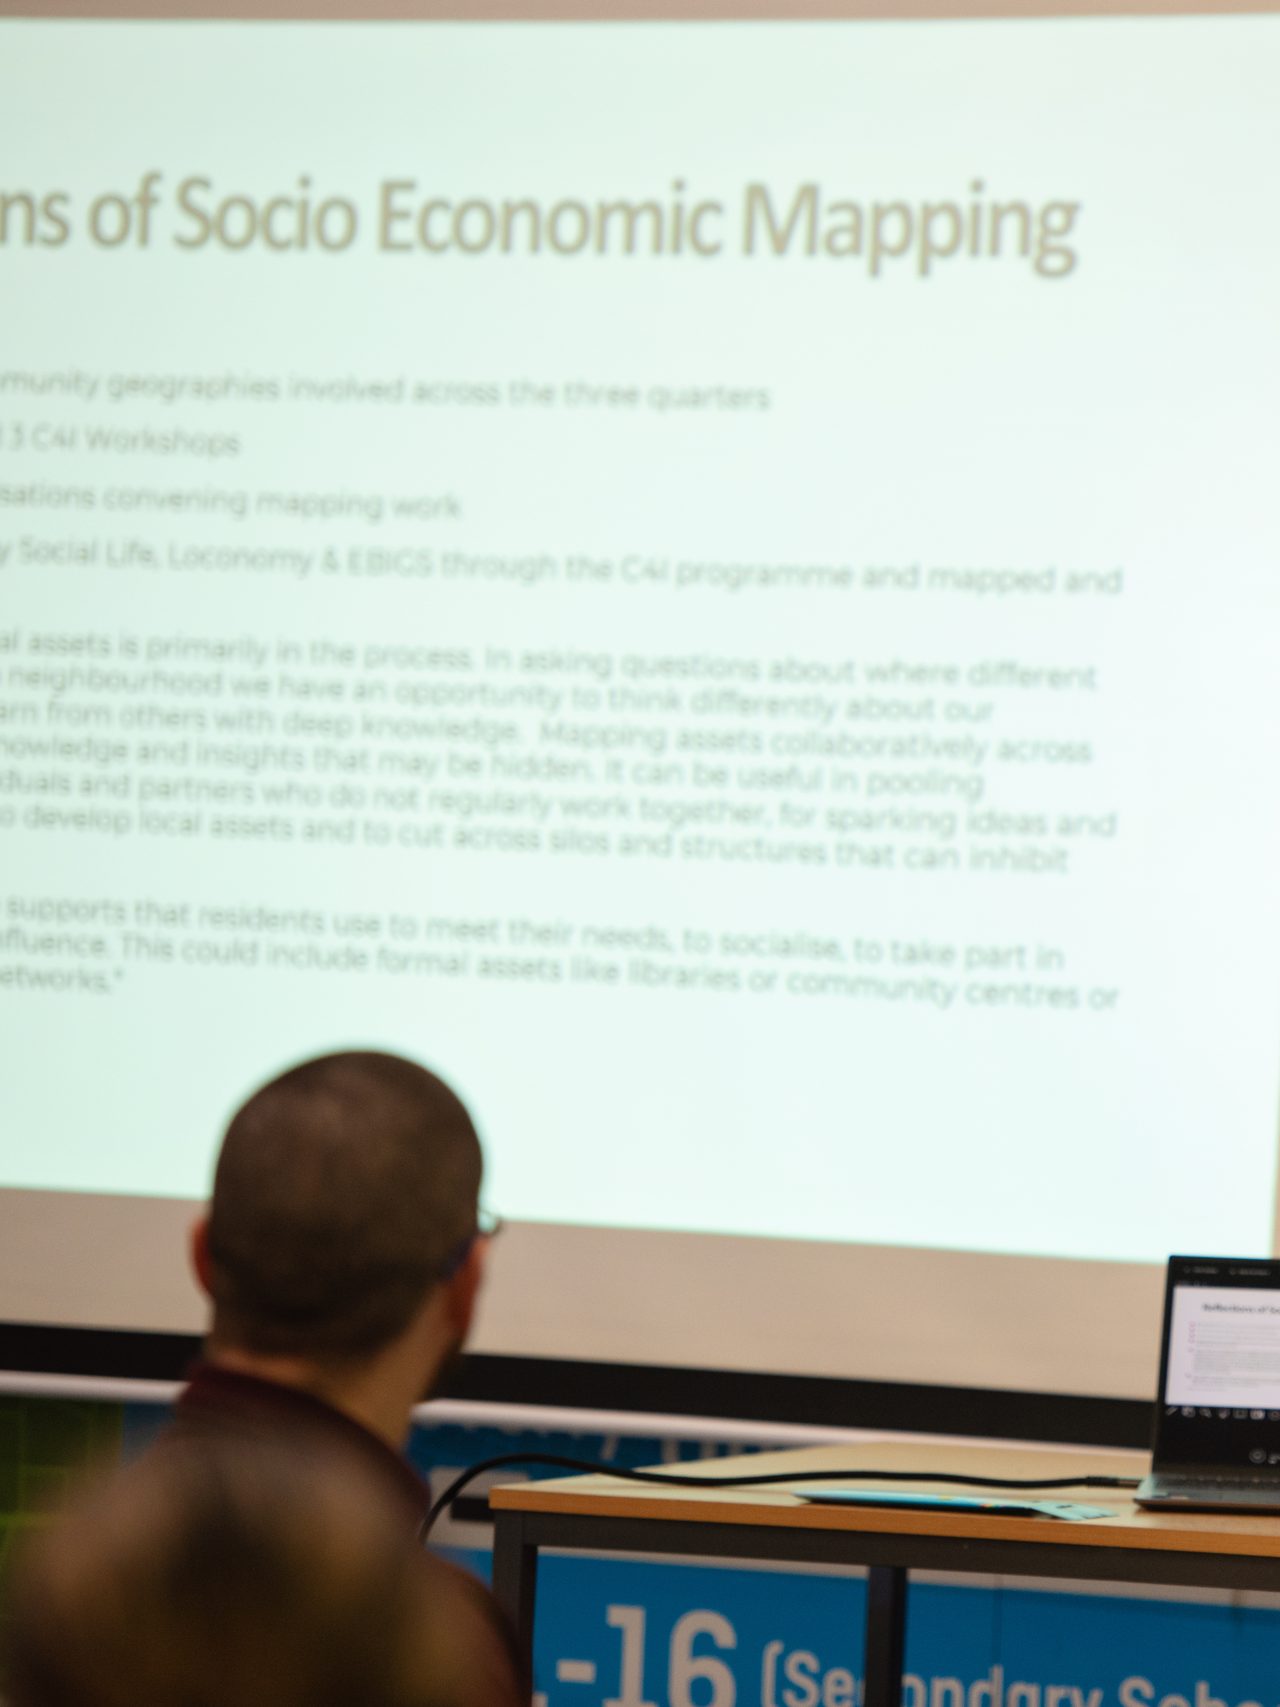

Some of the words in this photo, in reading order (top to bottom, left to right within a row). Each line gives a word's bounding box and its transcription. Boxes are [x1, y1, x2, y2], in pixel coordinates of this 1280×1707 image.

[87, 170, 162, 250] of
[173, 174, 358, 254] Socio
[379, 180, 724, 258] Economic
[742, 180, 1080, 279] Mapping
[0, 924, 109, 957] fluence.
